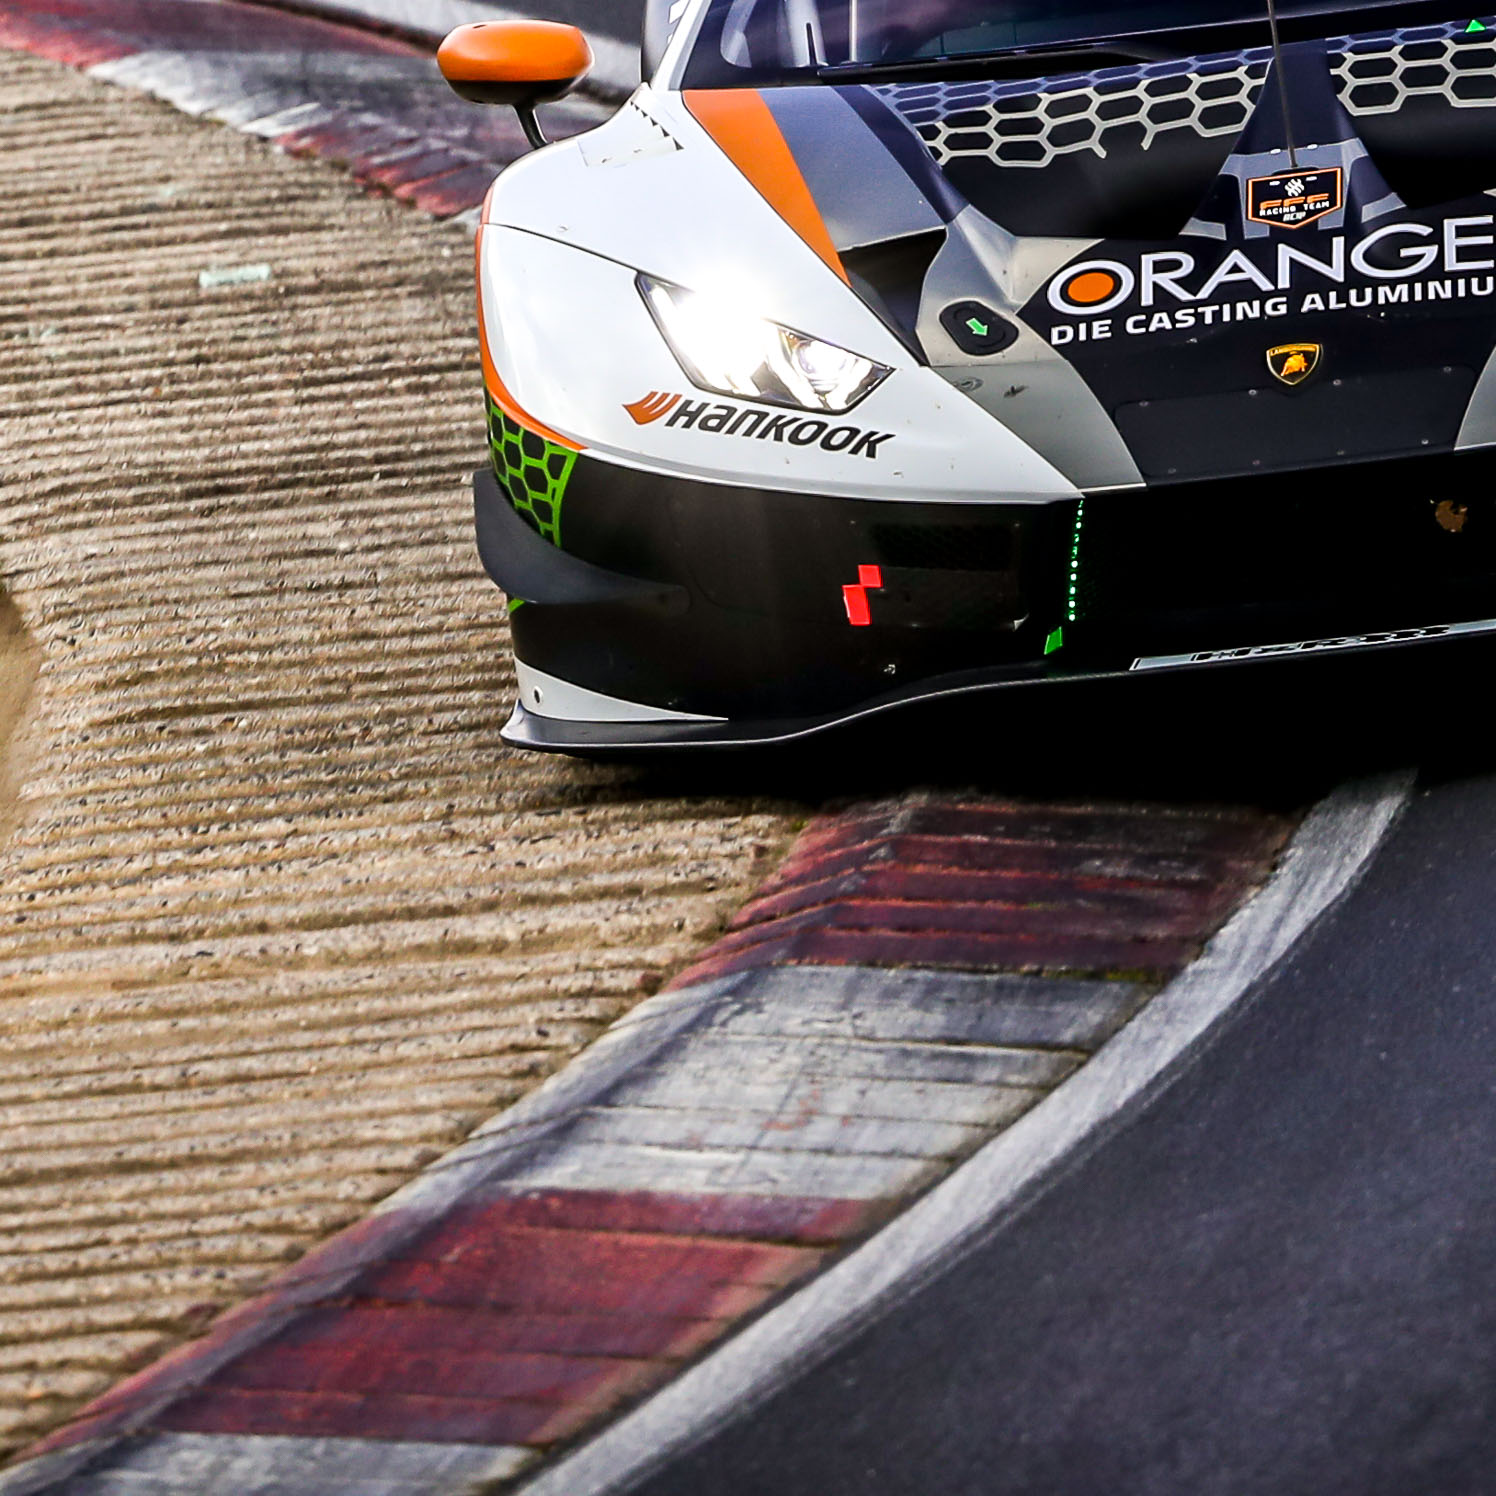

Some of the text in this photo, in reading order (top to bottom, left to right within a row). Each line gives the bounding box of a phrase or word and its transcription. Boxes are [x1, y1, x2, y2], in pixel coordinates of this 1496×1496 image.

[1259, 201, 1330, 216] RACING TEAM
[1260, 193, 1329, 209] FFF
[1051, 319, 1113, 345] DIE
[1125, 297, 1288, 335] CASTING
